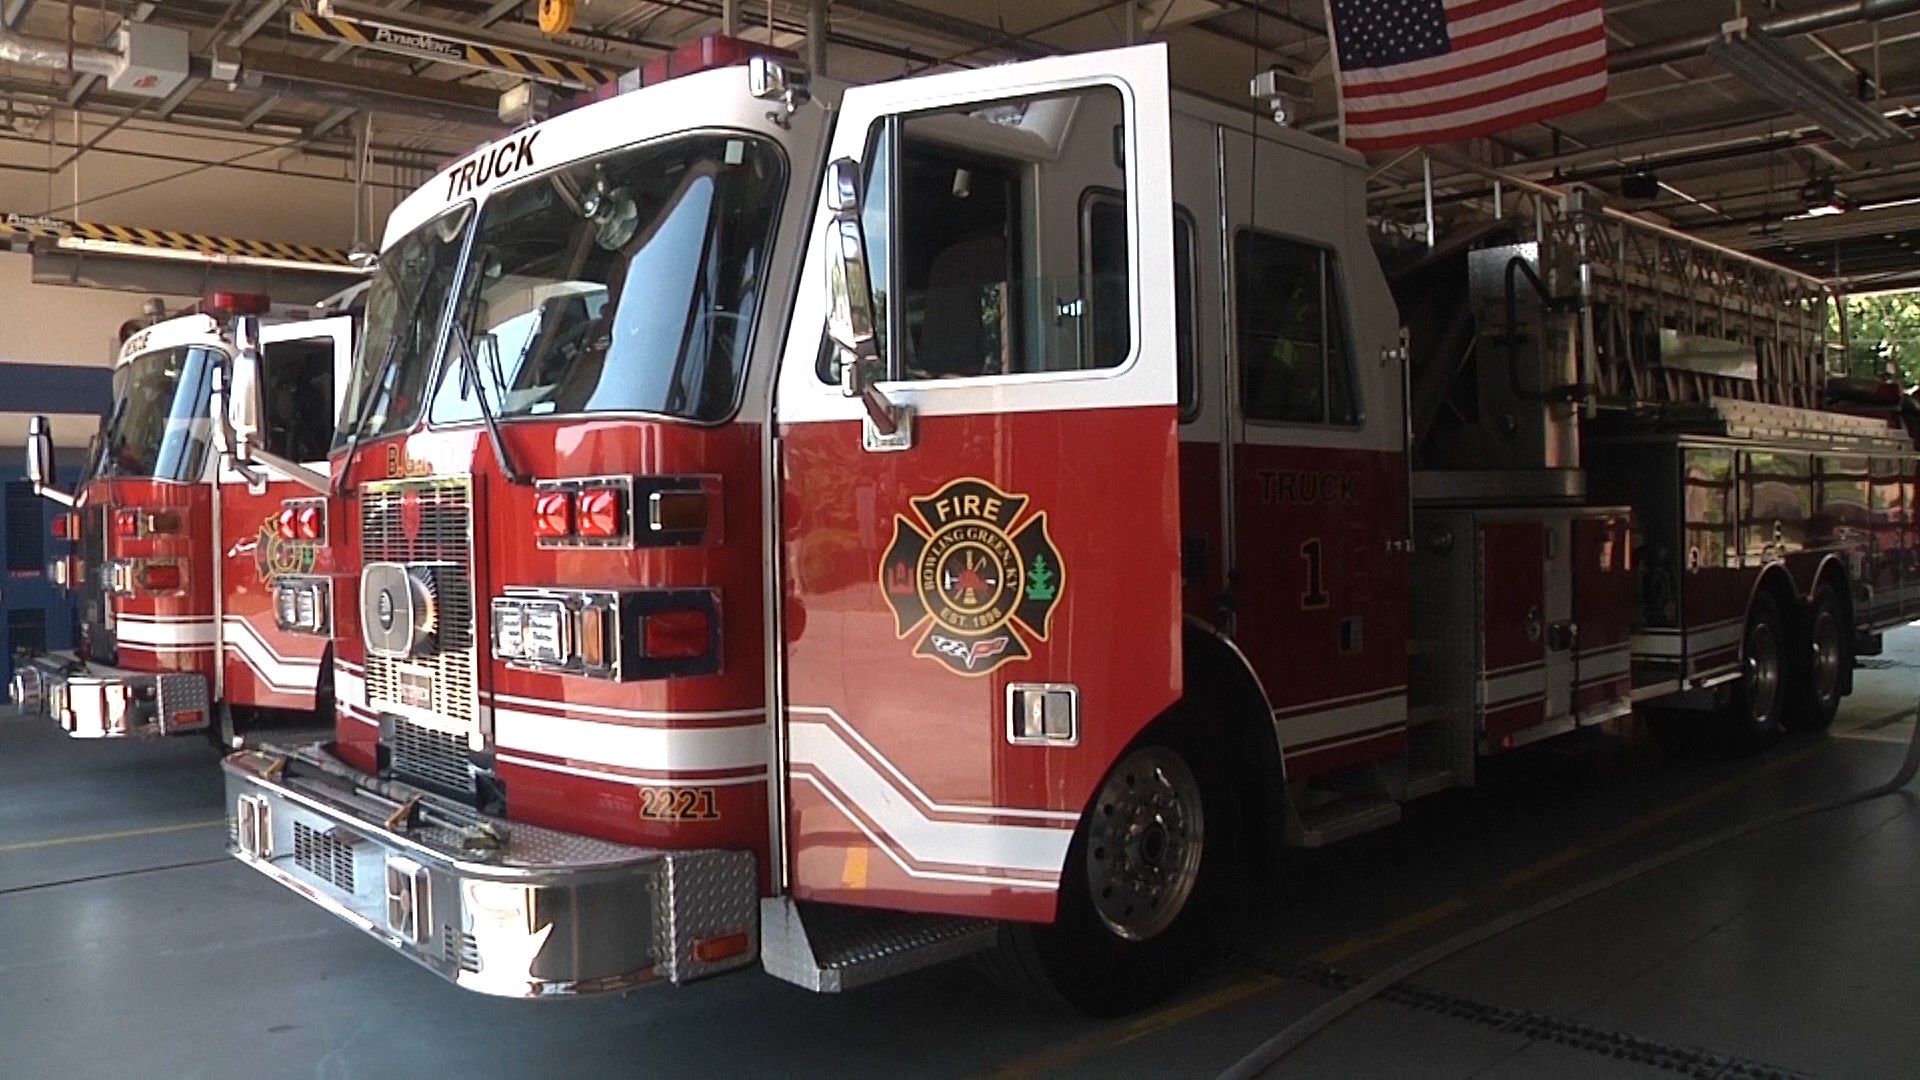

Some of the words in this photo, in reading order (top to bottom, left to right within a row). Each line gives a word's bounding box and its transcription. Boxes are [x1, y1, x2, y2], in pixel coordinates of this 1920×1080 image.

[447, 129, 541, 201] TRUCK
[936, 494, 1002, 521] FIRE
[1257, 468, 1359, 504] TRUCK
[923, 528, 965, 591] BOWLING
[1300, 537, 1330, 610] 1
[639, 786, 721, 821] 2221
